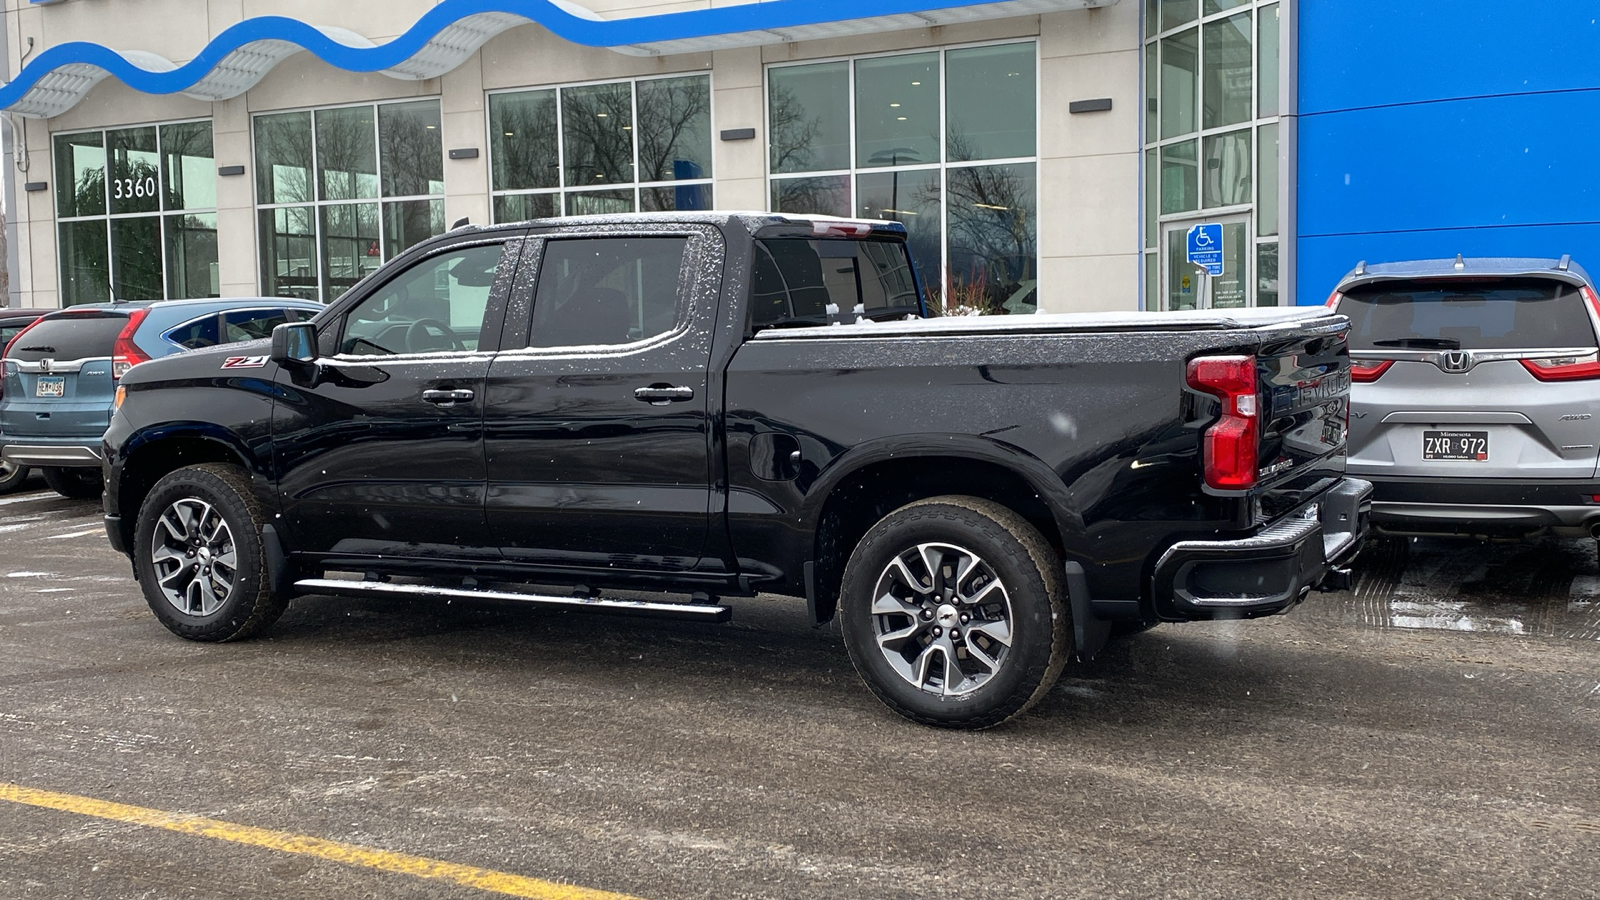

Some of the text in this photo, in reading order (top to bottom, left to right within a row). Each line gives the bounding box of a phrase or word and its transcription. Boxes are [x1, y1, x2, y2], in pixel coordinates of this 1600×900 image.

[114, 177, 155, 199] 3360
[220, 355, 271, 369] Z71
[1275, 372, 1351, 413] CHEVROLE
[1558, 413, 1592, 421] AWD
[1425, 438, 1486, 454] ZXR 972
